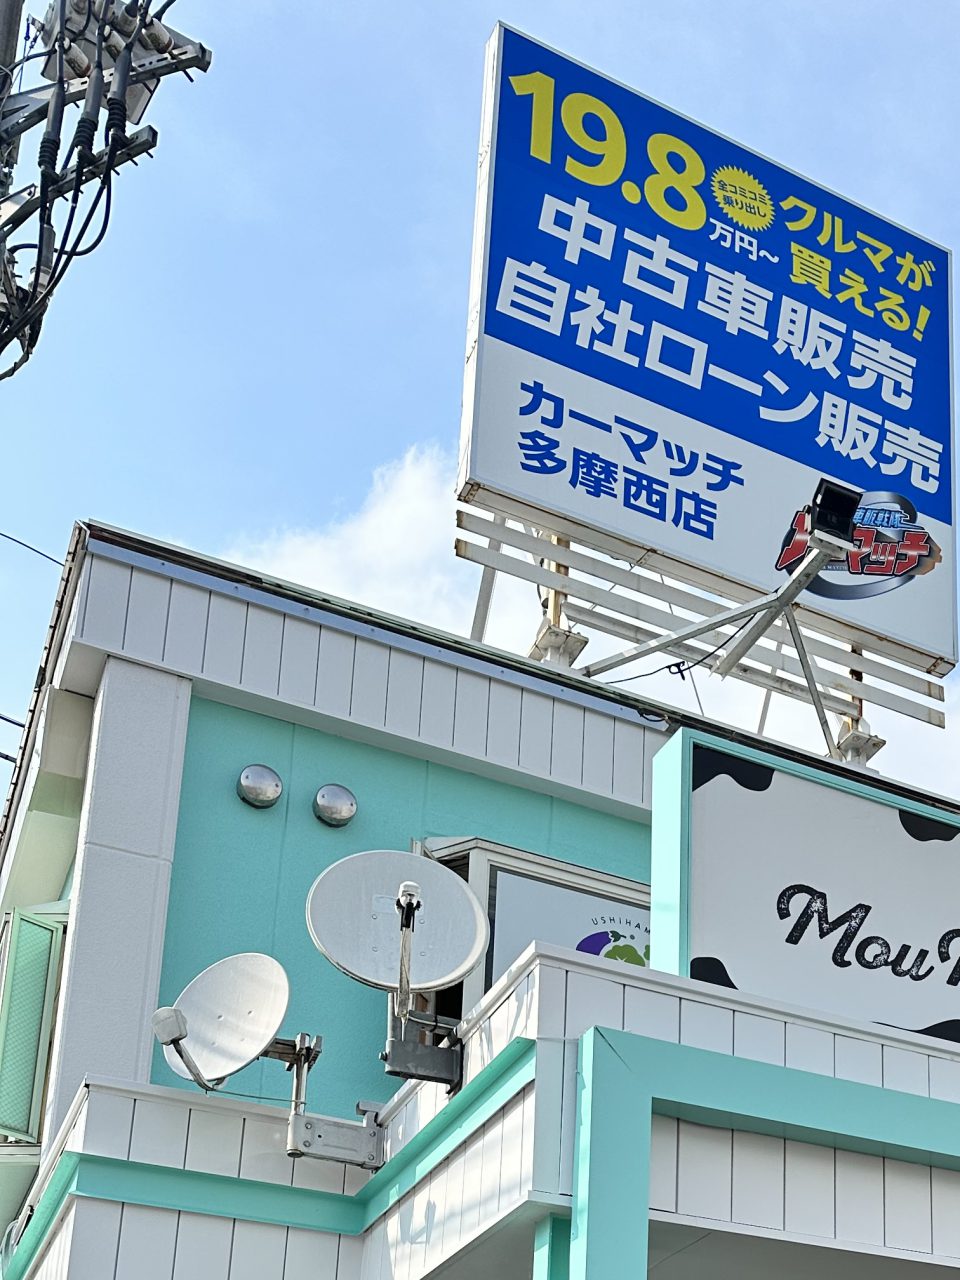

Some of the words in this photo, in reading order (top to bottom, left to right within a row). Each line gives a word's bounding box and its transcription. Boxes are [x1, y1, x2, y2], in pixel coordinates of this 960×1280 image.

[508, 71, 707, 231] 19.8
[717, 180, 768, 206] 全コミコミ
[722, 194, 767, 218] 乗り出し
[779, 195, 937, 292] クルマが
[538, 193, 917, 410] 中古車販売
[495, 258, 943, 494] 自社ローン販売
[518, 381, 745, 492] カーマッチ
[518, 430, 718, 540] 多摩西店
[591, 916, 650, 935] USHIHAM
